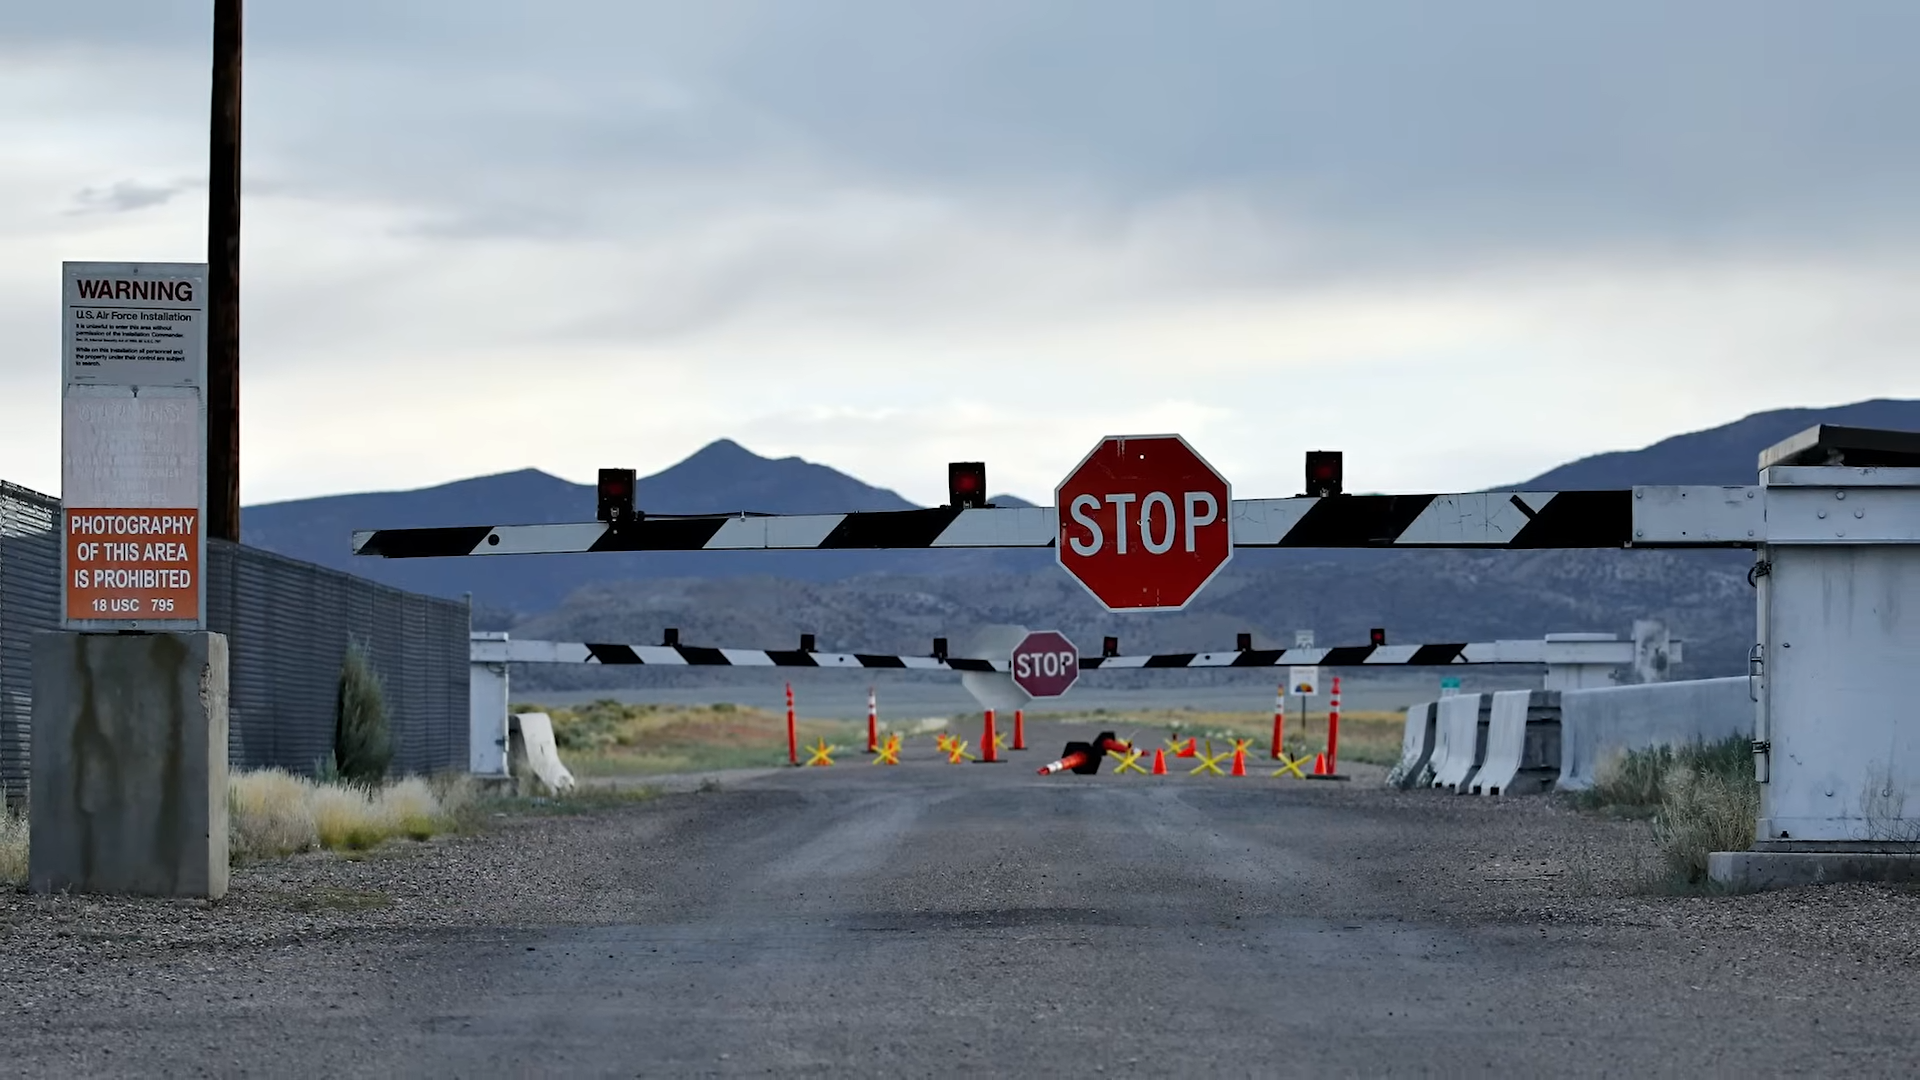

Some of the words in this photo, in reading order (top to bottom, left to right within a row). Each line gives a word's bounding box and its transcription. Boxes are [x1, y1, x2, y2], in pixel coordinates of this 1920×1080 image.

[77, 280, 192, 301] WARNING
[76, 310, 94, 320] U.S.
[96, 311, 109, 320] Air
[111, 311, 138, 320] Force
[140, 312, 192, 322] Installation
[71, 516, 194, 534] PHOTOGRAPHY
[1070, 491, 1218, 557] STOP
[78, 543, 99, 561] OF
[104, 543, 139, 561] THIS
[143, 543, 188, 561] AREA
[75, 570, 89, 588] IS
[94, 570, 191, 588] PROHIBITED
[92, 599, 107, 611] 18
[111, 599, 139, 611] USC
[151, 599, 174, 611] 795
[1017, 652, 1074, 678] STOP
